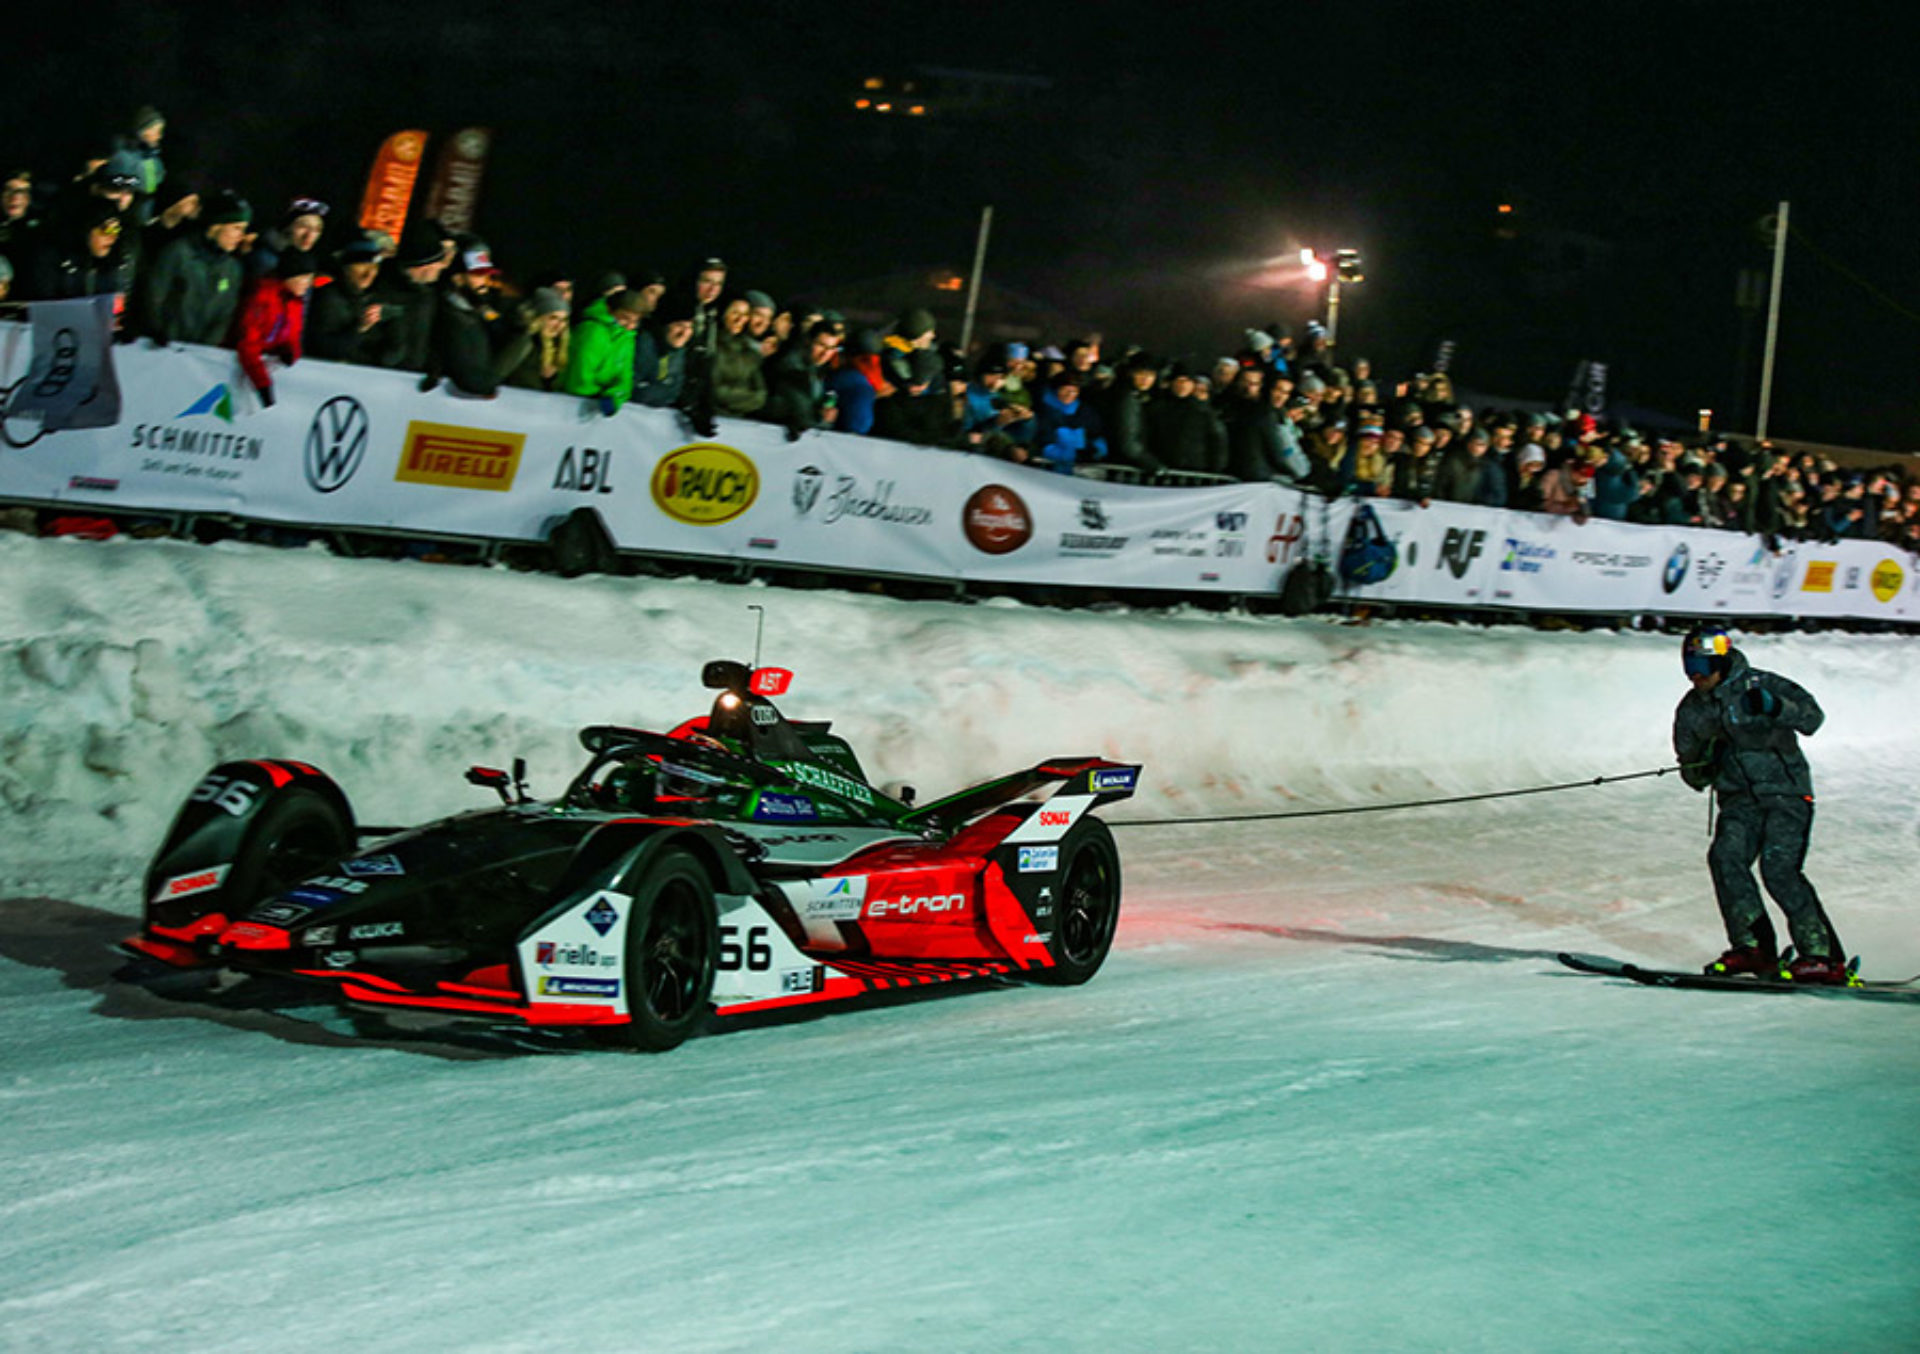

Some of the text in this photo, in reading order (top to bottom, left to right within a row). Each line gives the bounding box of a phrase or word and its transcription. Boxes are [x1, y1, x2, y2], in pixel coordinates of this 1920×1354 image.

[130, 424, 264, 460] SCHMITTEN
[407, 434, 514, 479] PIRELLI
[553, 446, 613, 493] ABL
[677, 464, 752, 504] RAUCH
[793, 761, 875, 806] SCHAEFFLER
[867, 894, 965, 916] e-tron
